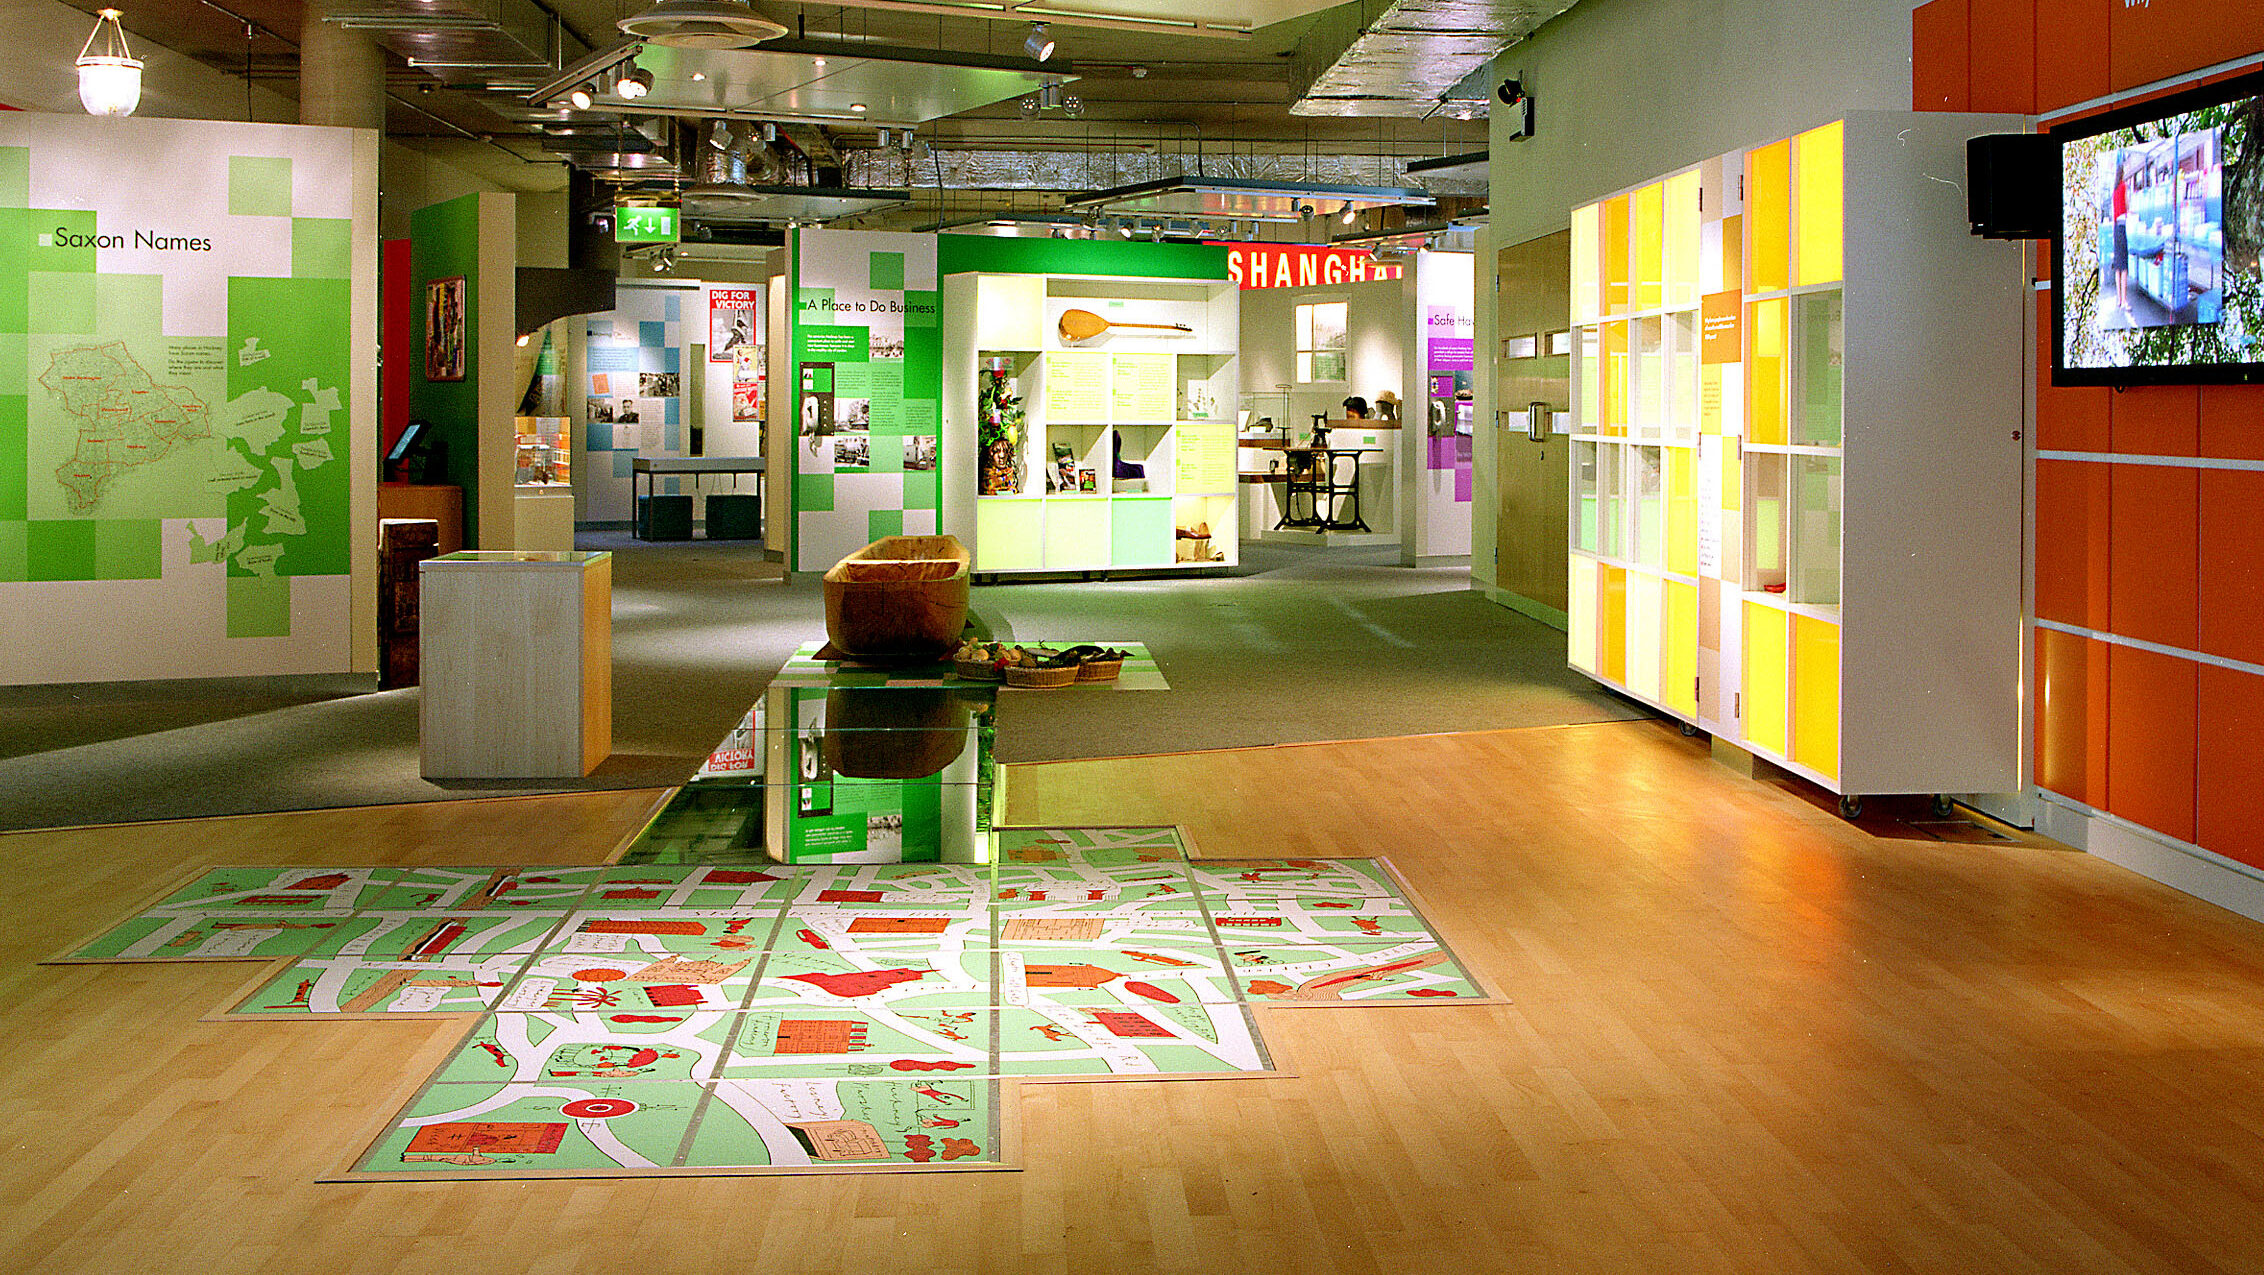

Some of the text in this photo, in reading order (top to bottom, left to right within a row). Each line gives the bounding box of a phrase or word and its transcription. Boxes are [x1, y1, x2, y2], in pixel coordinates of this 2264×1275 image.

[55, 226, 212, 252] Saxon Names
[712, 290, 750, 300] DIG FOR
[716, 300, 756, 310] VICTORY
[808, 298, 936, 314] A Place to Do Business
[1434, 314, 1455, 326] Safe
